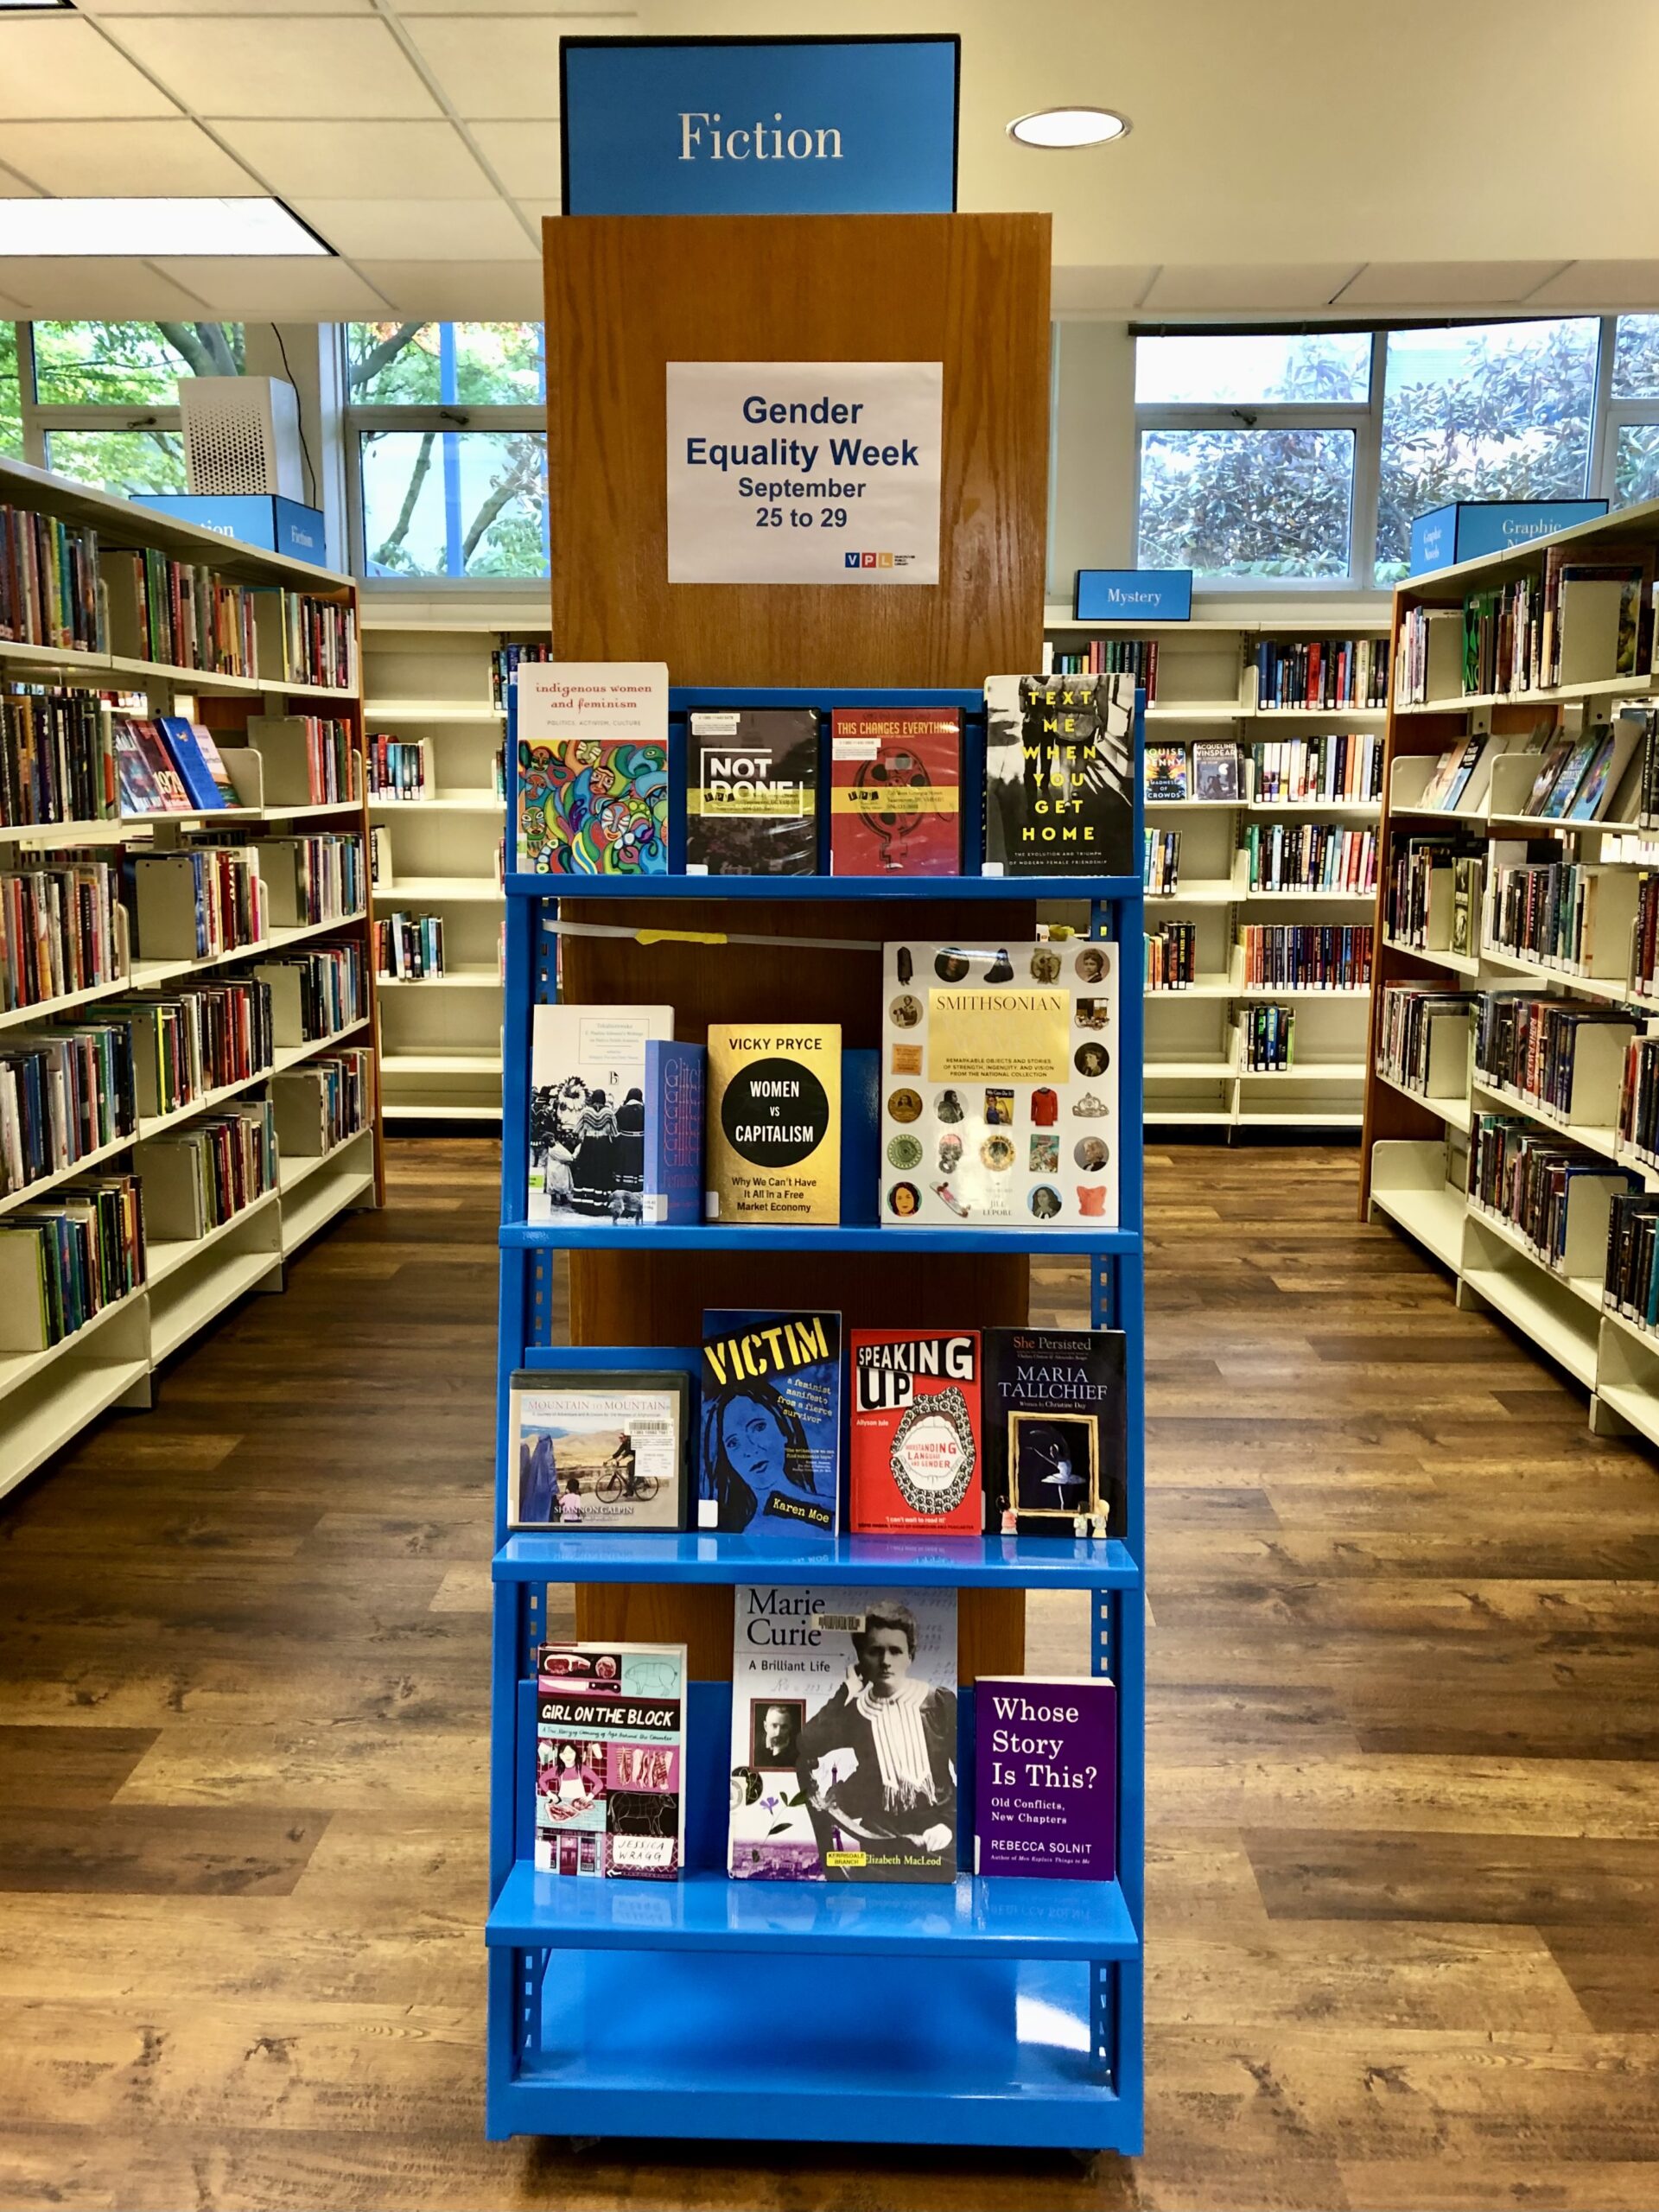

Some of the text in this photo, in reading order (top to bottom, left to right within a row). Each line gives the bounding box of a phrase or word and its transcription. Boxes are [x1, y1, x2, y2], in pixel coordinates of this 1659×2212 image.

[677, 112, 843, 161] Fiction
[742, 395, 864, 424] Gender
[686, 436, 919, 473] Equality Week
[738, 476, 866, 502] September
[756, 507, 848, 528] 25 to 29
[1503, 518, 1562, 537] Graphic
[291, 525, 314, 548] Fiction
[1107, 588, 1162, 607] Mystery
[536, 683, 607, 697] indigenous
[1028, 691, 1092, 705] TEXT
[550, 698, 638, 714] and feminism
[837, 722, 857, 734] THIS
[860, 721, 900, 734] CHANGES
[1044, 719, 1076, 733] ME
[1022, 746, 1096, 760] WHEN
[710, 758, 772, 778] NOT
[1033, 772, 1085, 786] YOU
[710, 780, 793, 800] DONE
[1034, 800, 1084, 814] GET
[1022, 827, 1095, 842] HOME
[937, 995, 1061, 1011] SMITHSONIAN
[728, 1038, 823, 1051] VICKY PRYCE
[750, 1080, 800, 1098] WOMEN
[769, 1105, 780, 1117] VS
[735, 1125, 814, 1143] CAPITALISM
[732, 1177, 817, 1188] Why We Can't Have
[744, 1190, 751, 1199] It
[753, 1190, 765, 1199] All
[766, 1190, 775, 1199] in
[784, 1190, 804, 1199] Free
[737, 1202, 811, 1213] Market Economy
[704, 1317, 830, 1385] VICTIM
[1014, 1336, 1091, 1351] She Persisted
[859, 1337, 973, 1381] SPEAKING
[1016, 1366, 1089, 1382] MARIA
[794, 1378, 831, 1395] feminist
[860, 1369, 911, 1409] UP
[998, 1382, 1108, 1400] TALLCHIEF
[786, 1388, 829, 1405] manifesto
[528, 1401, 589, 1410] MOUNTAIN
[605, 1401, 666, 1410] MOUNTAIN
[777, 1395, 797, 1407] from
[804, 1402, 833, 1416] fierce
[783, 1408, 822, 1424] survivor
[906, 1442, 957, 1455] UNDERSTANDING
[908, 1452, 941, 1460] LANGUAGE
[554, 1506, 634, 1515] SHANNON GALPIN
[773, 1497, 830, 1523] Karen Moe
[747, 1587, 825, 1616] Marie
[747, 1618, 822, 1647] Curie
[749, 1659, 830, 1673] A Brilliant Life
[542, 1704, 674, 1727] GIRL ON THE BLOCK
[992, 1697, 1079, 1723] Whose
[993, 1729, 1064, 1759] Story
[992, 1763, 1097, 1789] Is This?
[991, 1797, 1065, 1811] Old Conflicts,
[991, 1811, 1067, 1825] New Chapters
[618, 1840, 664, 1851] JESSICA
[991, 1840, 1092, 1854] REBECCA SOLNIT
[619, 1851, 662, 1862] WRAGG
[866, 1853, 942, 1866] Elizabeth MacLeod
